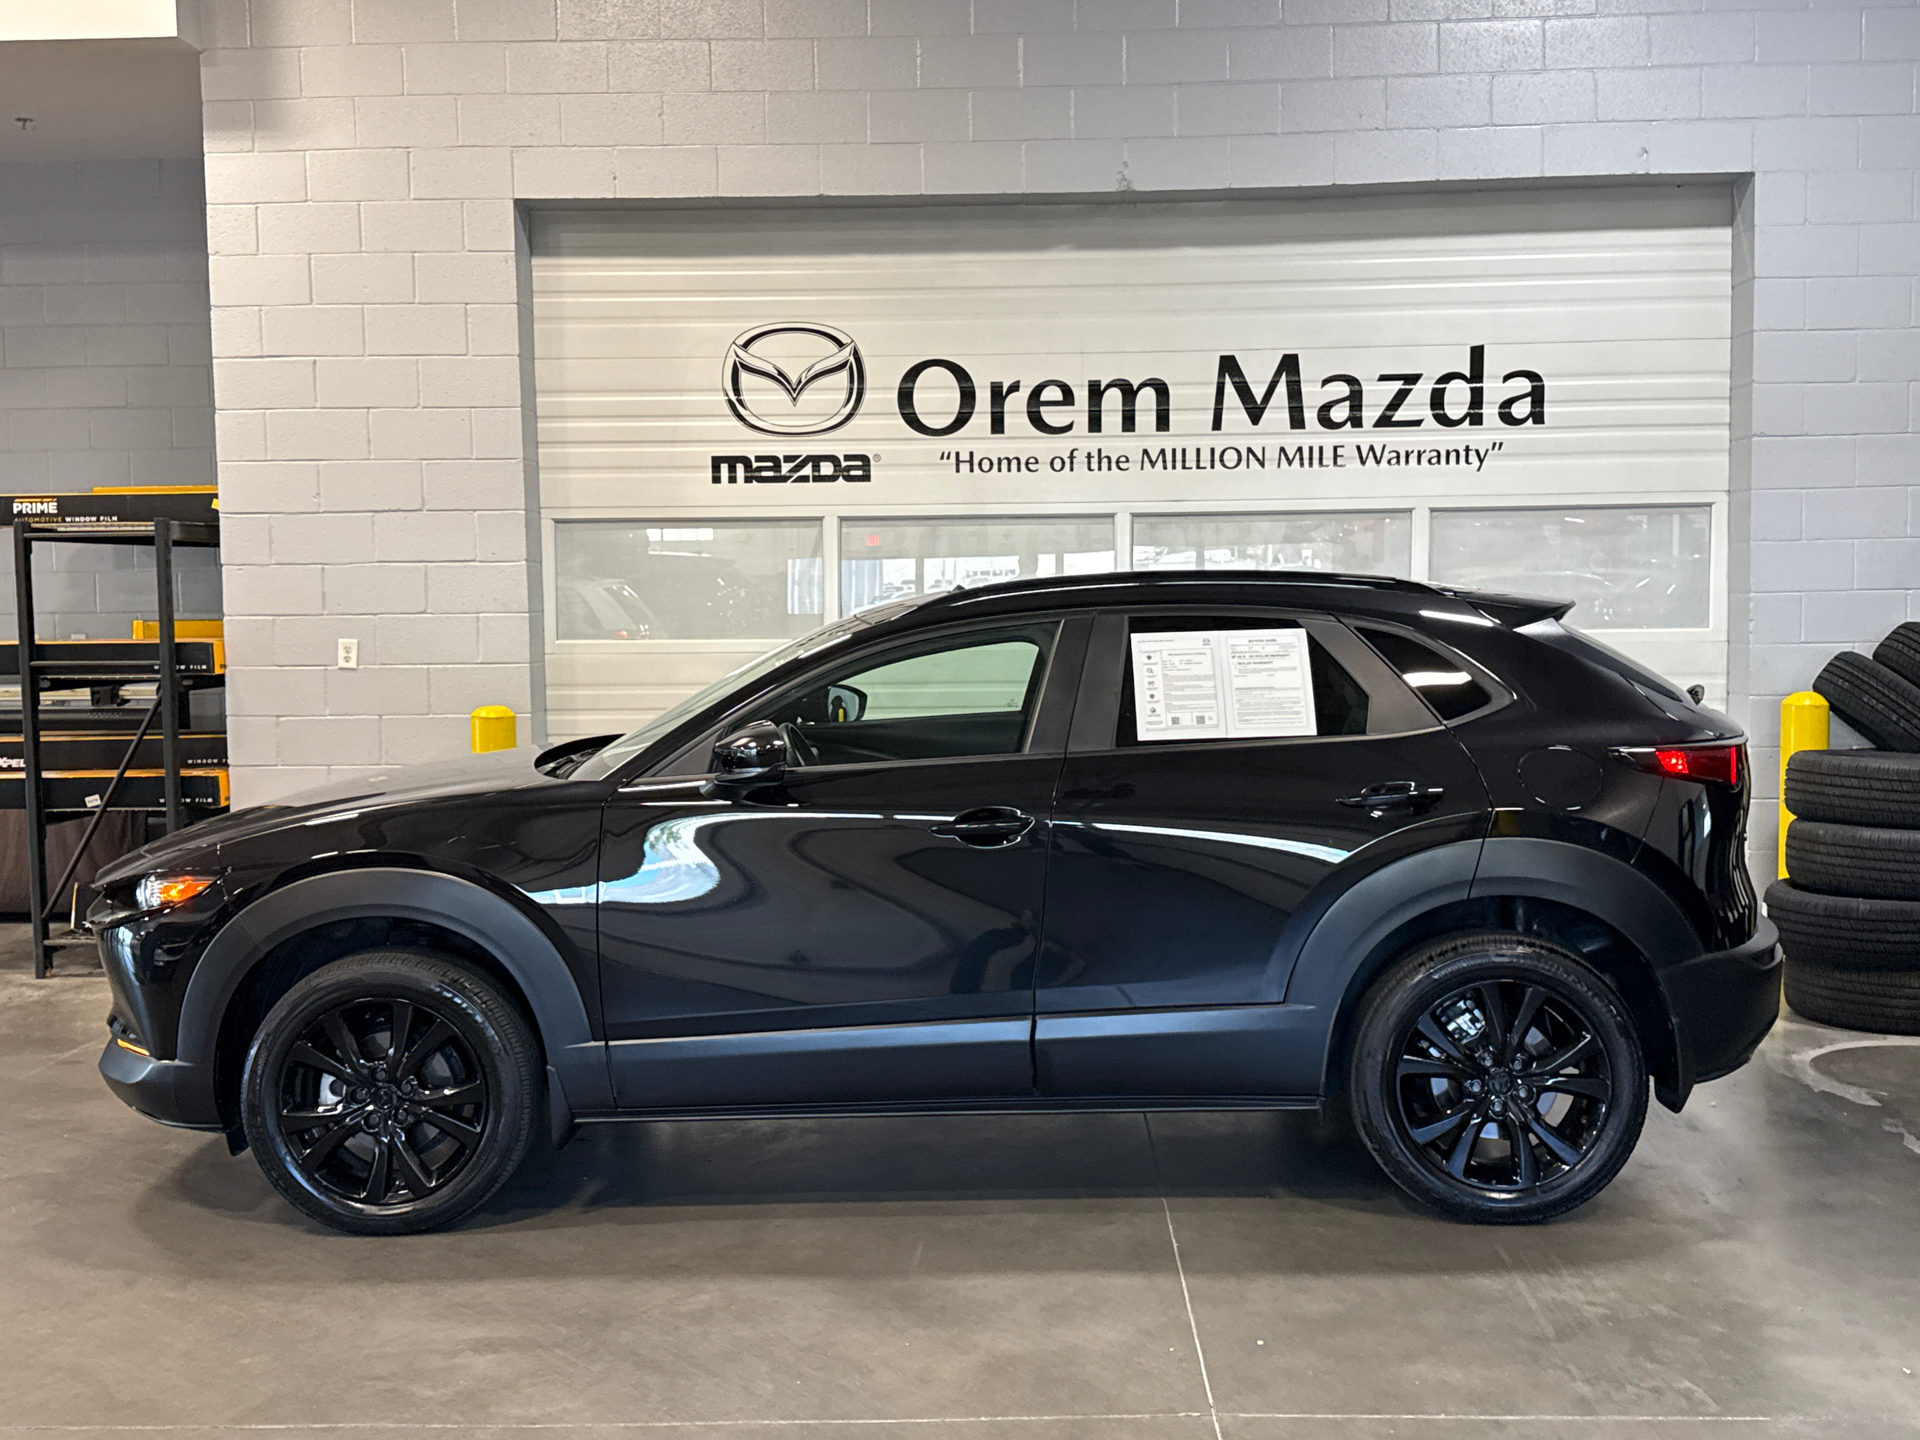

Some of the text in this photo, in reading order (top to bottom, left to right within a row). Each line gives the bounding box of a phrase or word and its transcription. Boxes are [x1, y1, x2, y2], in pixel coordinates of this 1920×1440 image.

[897, 344, 1545, 437] Orem Mazda
[1049, 448, 1079, 473] of
[1085, 447, 1130, 472] the
[1140, 446, 1266, 471] MILLION
[1277, 444, 1345, 469] MILE
[12, 502, 58, 514] PRIME
